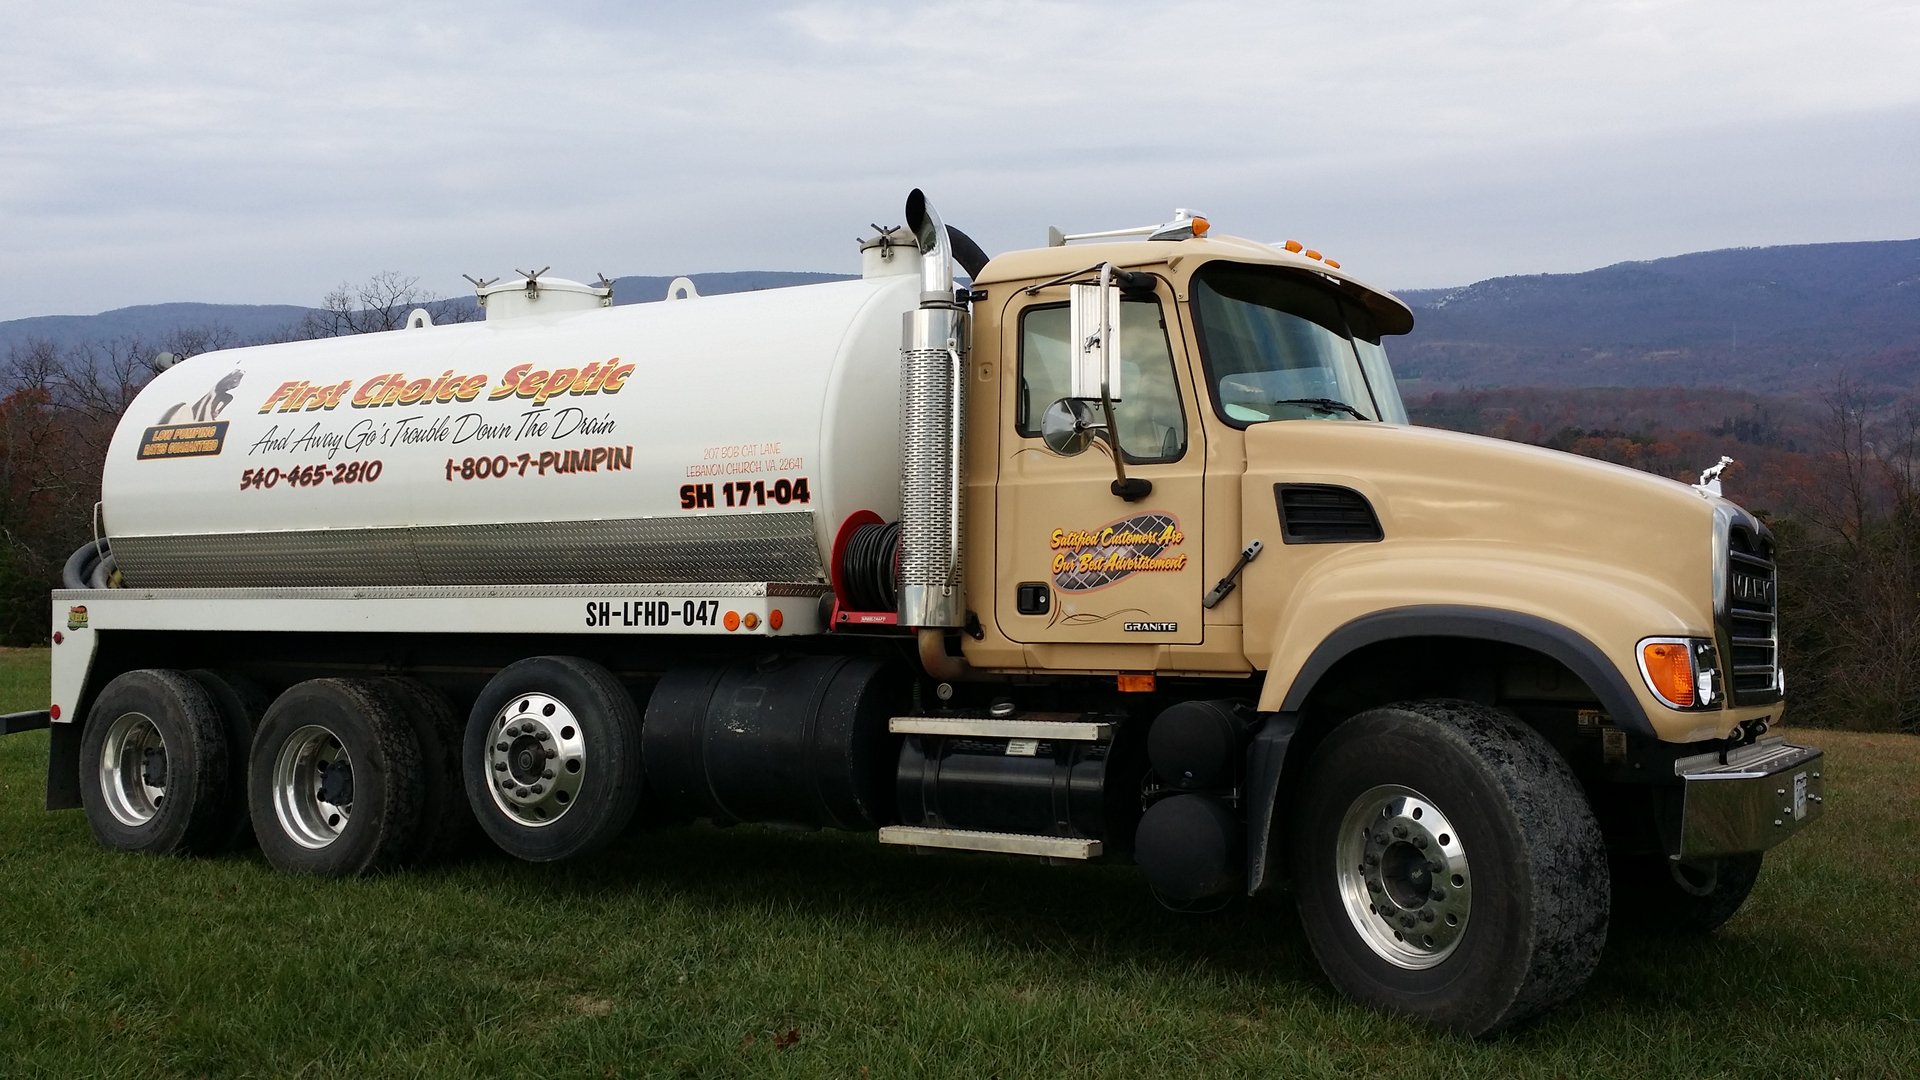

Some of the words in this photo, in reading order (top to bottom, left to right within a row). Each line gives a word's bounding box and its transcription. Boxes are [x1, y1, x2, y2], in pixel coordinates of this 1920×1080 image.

[258, 379, 352, 414] First
[351, 369, 488, 409] Choice
[488, 357, 637, 407] Septic
[249, 424, 295, 455] And
[290, 421, 343, 460] Away
[344, 418, 390, 453] Go's
[390, 415, 451, 447] Trouble
[451, 413, 513, 444] Down
[515, 408, 550, 441] The
[551, 407, 617, 440] Drain
[445, 445, 634, 481] 1-800-7-PUMPIN
[704, 447, 719, 460] 207
[721, 446, 739, 459] BOB
[741, 444, 759, 457] CAT
[760, 442, 781, 455] LANE
[240, 459, 383, 491] 540-465-2810
[686, 464, 725, 478] LEBANON
[779, 457, 803, 471] 22641
[679, 483, 716, 510] SH
[722, 477, 811, 507] 171-04
[1050, 527, 1100, 552] Satisfied
[1099, 526, 1157, 548] Customers
[1156, 524, 1184, 546] Are
[1052, 553, 1077, 574] Our
[1077, 552, 1105, 574] Best
[1104, 552, 1187, 574] Advertisement
[585, 599, 720, 627] SH-LFHD-047
